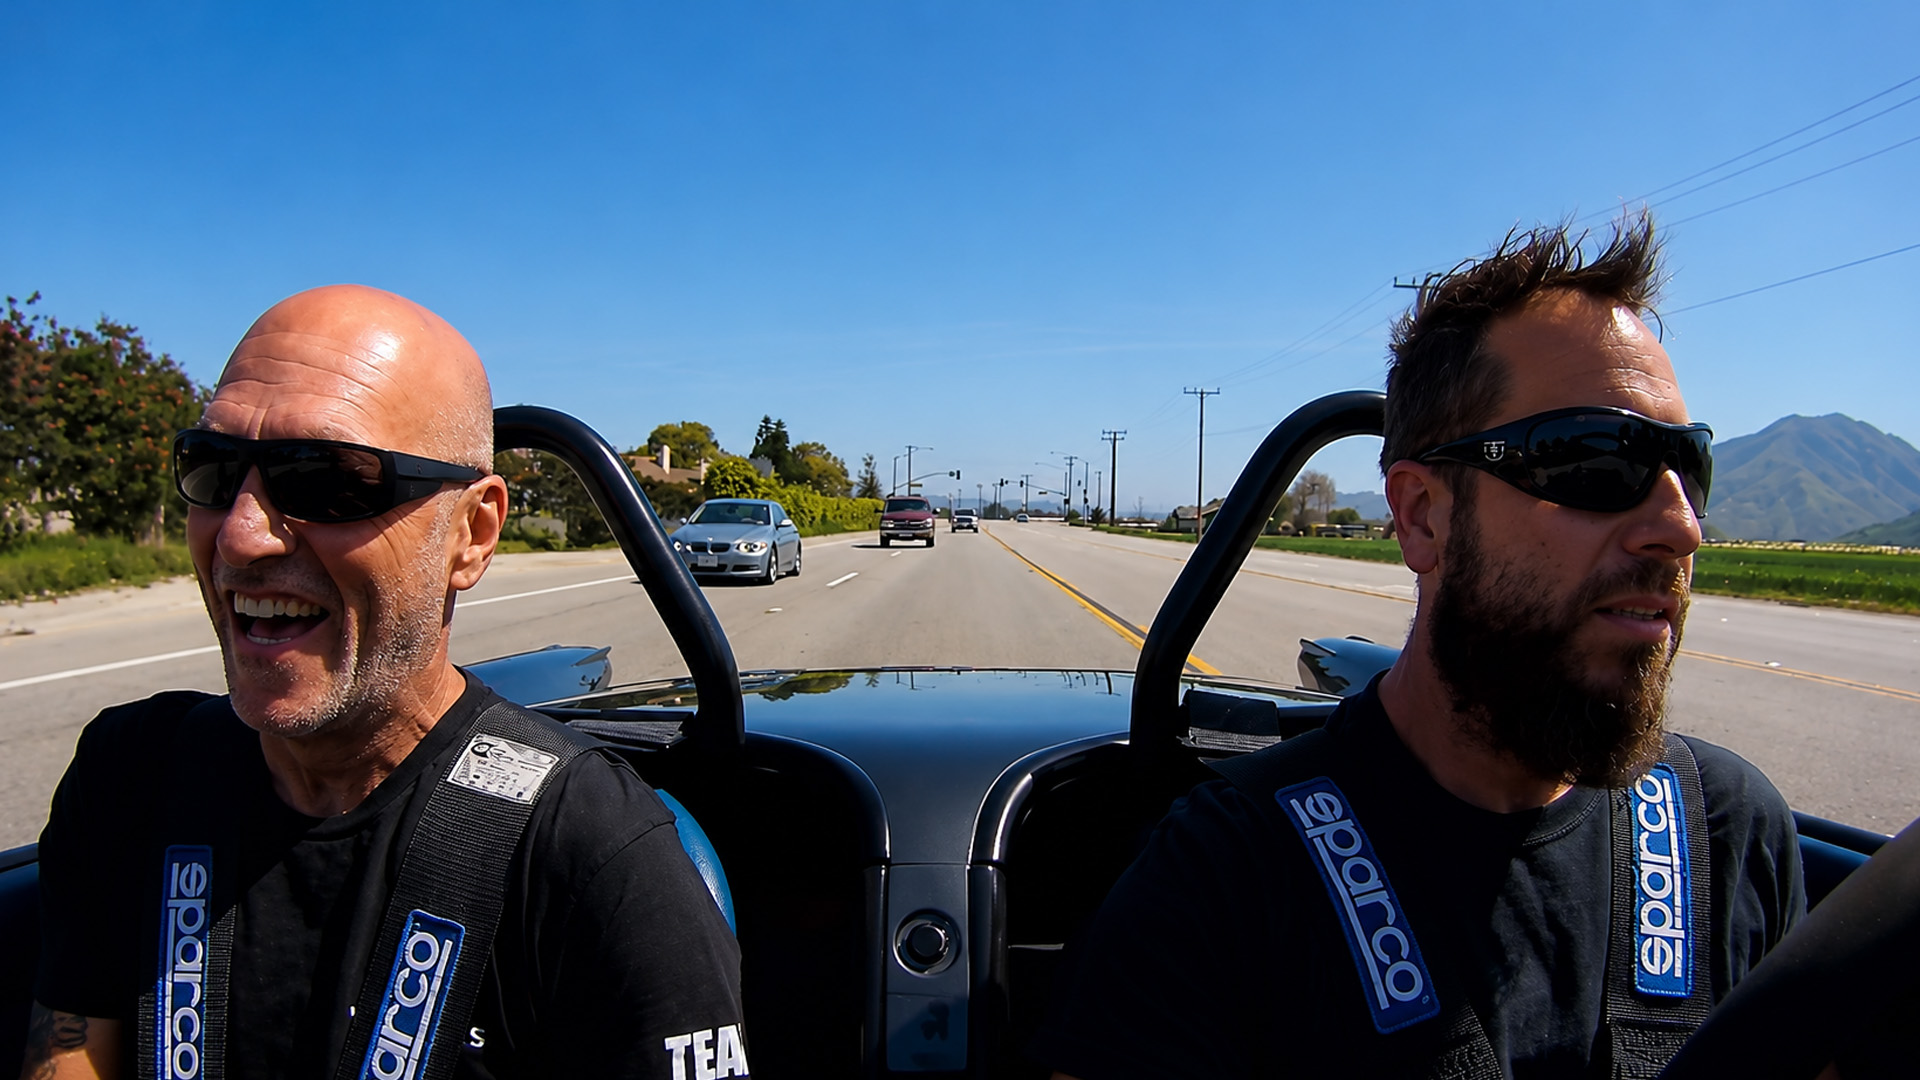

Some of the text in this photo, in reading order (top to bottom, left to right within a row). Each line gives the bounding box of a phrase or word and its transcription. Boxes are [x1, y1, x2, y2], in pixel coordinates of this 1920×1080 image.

[165, 862, 207, 1080] sparco
[1290, 791, 1424, 1010] sparco
[1635, 774, 1686, 978] sparco
[372, 931, 446, 1080] arco
[664, 1022, 749, 1080] TEA
